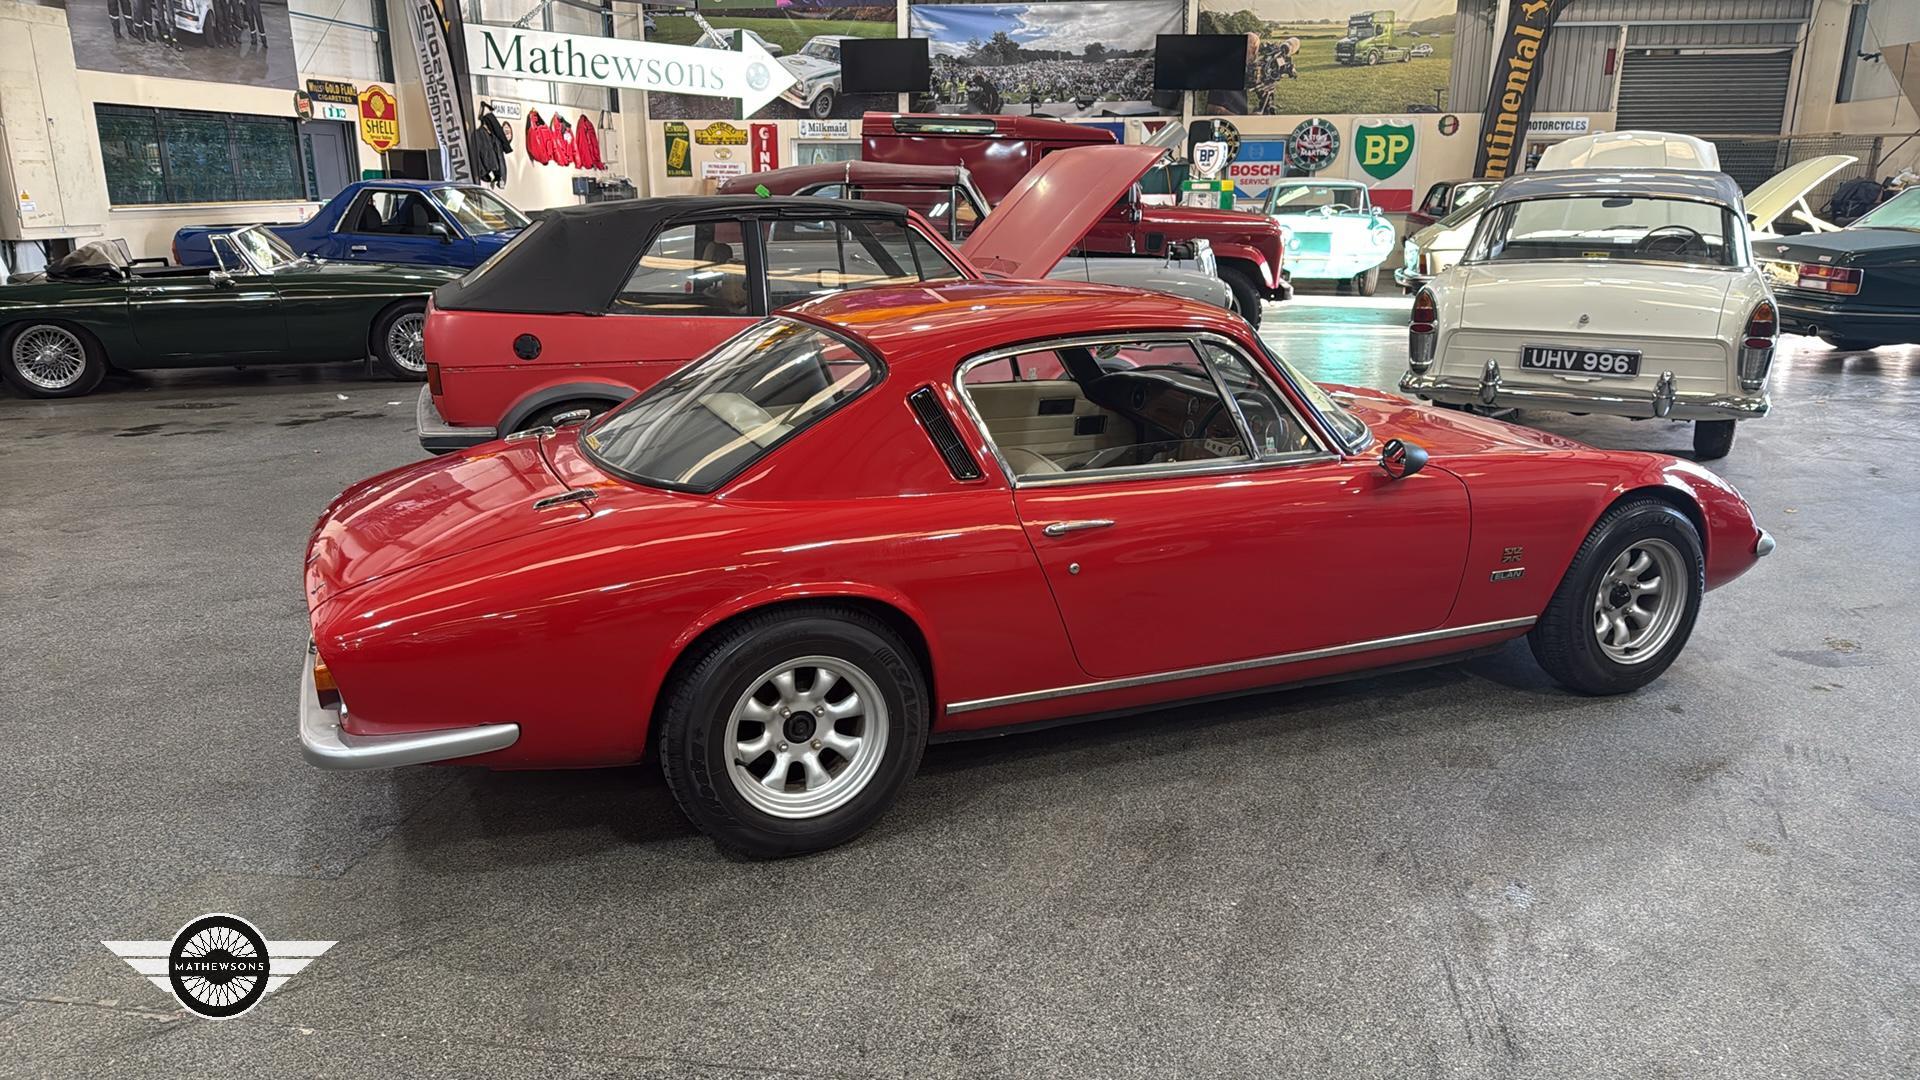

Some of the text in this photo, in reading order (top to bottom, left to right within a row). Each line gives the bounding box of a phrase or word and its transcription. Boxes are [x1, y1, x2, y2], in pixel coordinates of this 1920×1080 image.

[481, 30, 725, 91] Mathewsons
[507, 105, 520, 115] ROAD
[366, 119, 394, 135] SHELL
[808, 122, 848, 133] Milkmaid
[1200, 149, 1215, 162] BP
[1362, 134, 1409, 166] BP
[1230, 164, 1280, 177] BOSCH
[1532, 349, 1630, 373] UHV 996
[1494, 570, 1522, 580] ELAN
